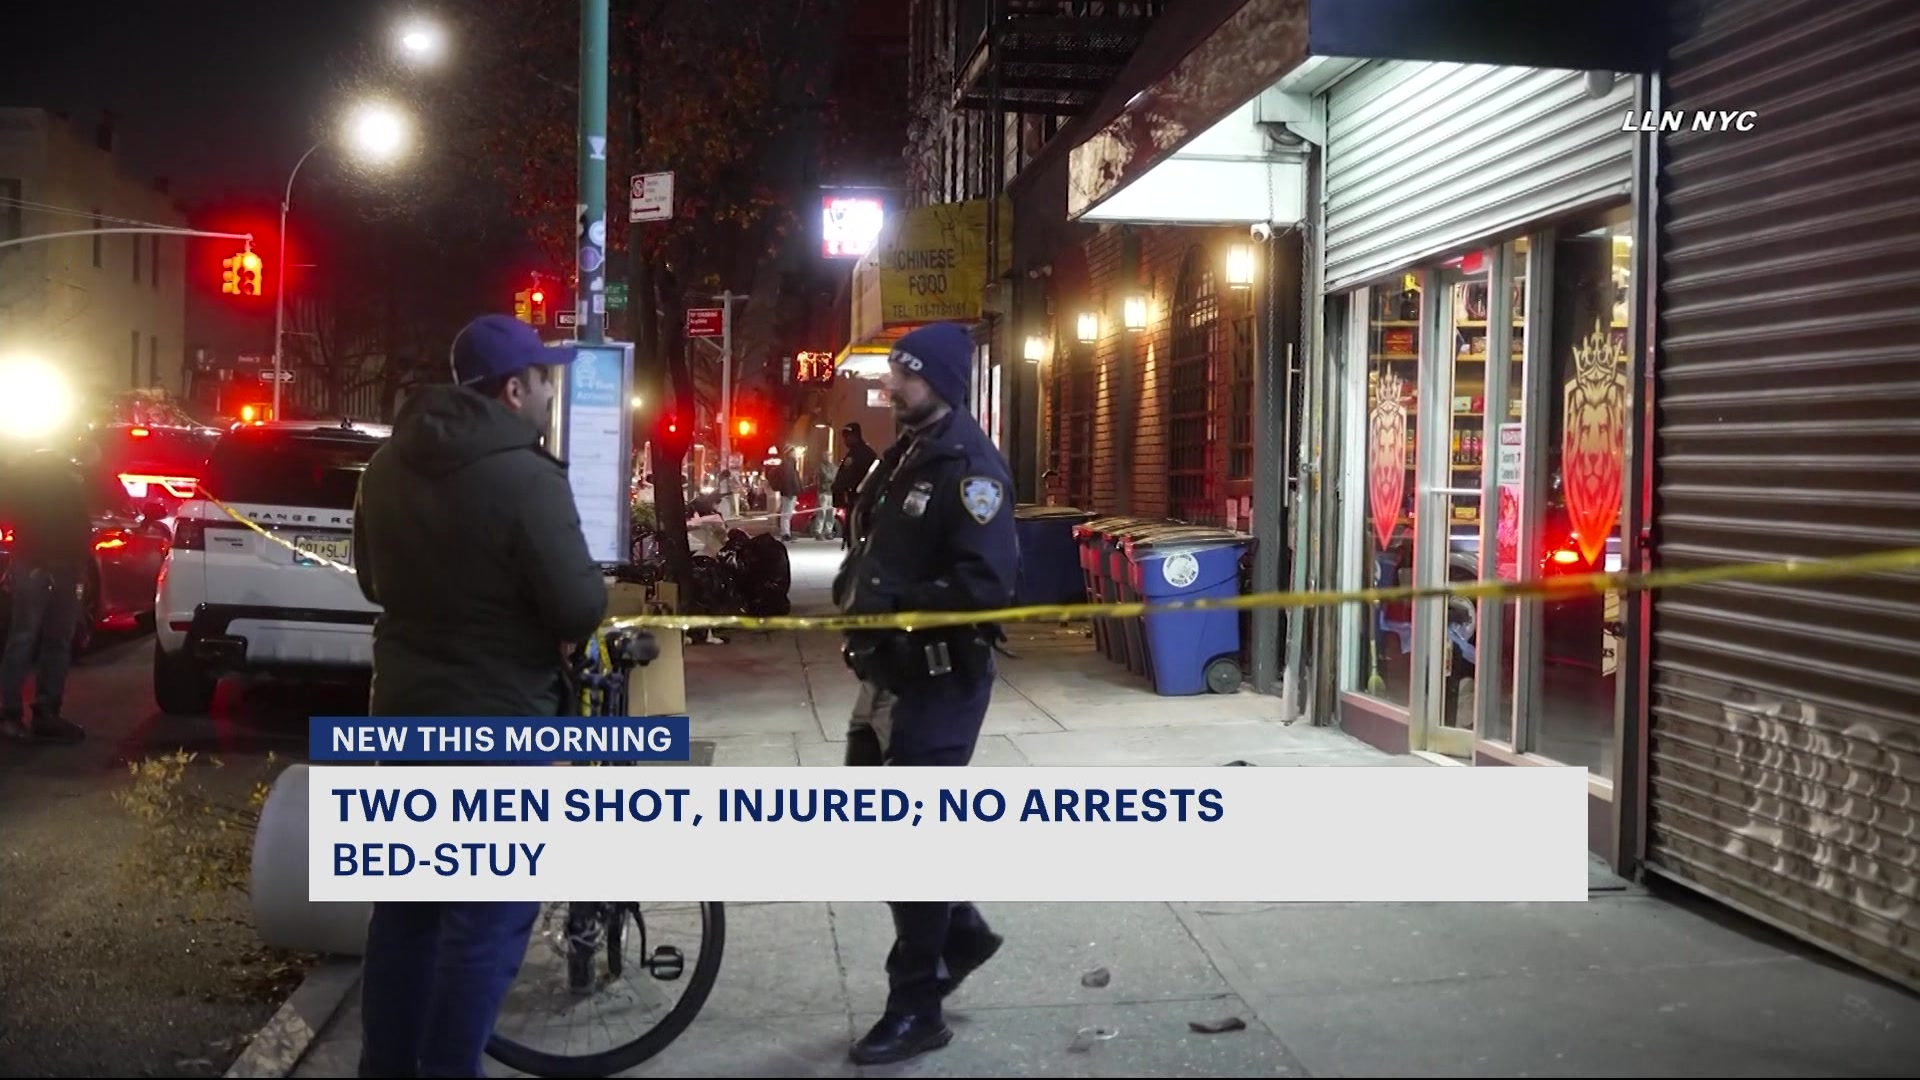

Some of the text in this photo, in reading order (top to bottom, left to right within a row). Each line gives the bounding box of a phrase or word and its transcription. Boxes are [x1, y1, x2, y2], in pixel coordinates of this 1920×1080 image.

[896, 248, 956, 271] CHINESE
[909, 274, 947, 296] FOOD
[248, 511, 317, 522] RANGE
